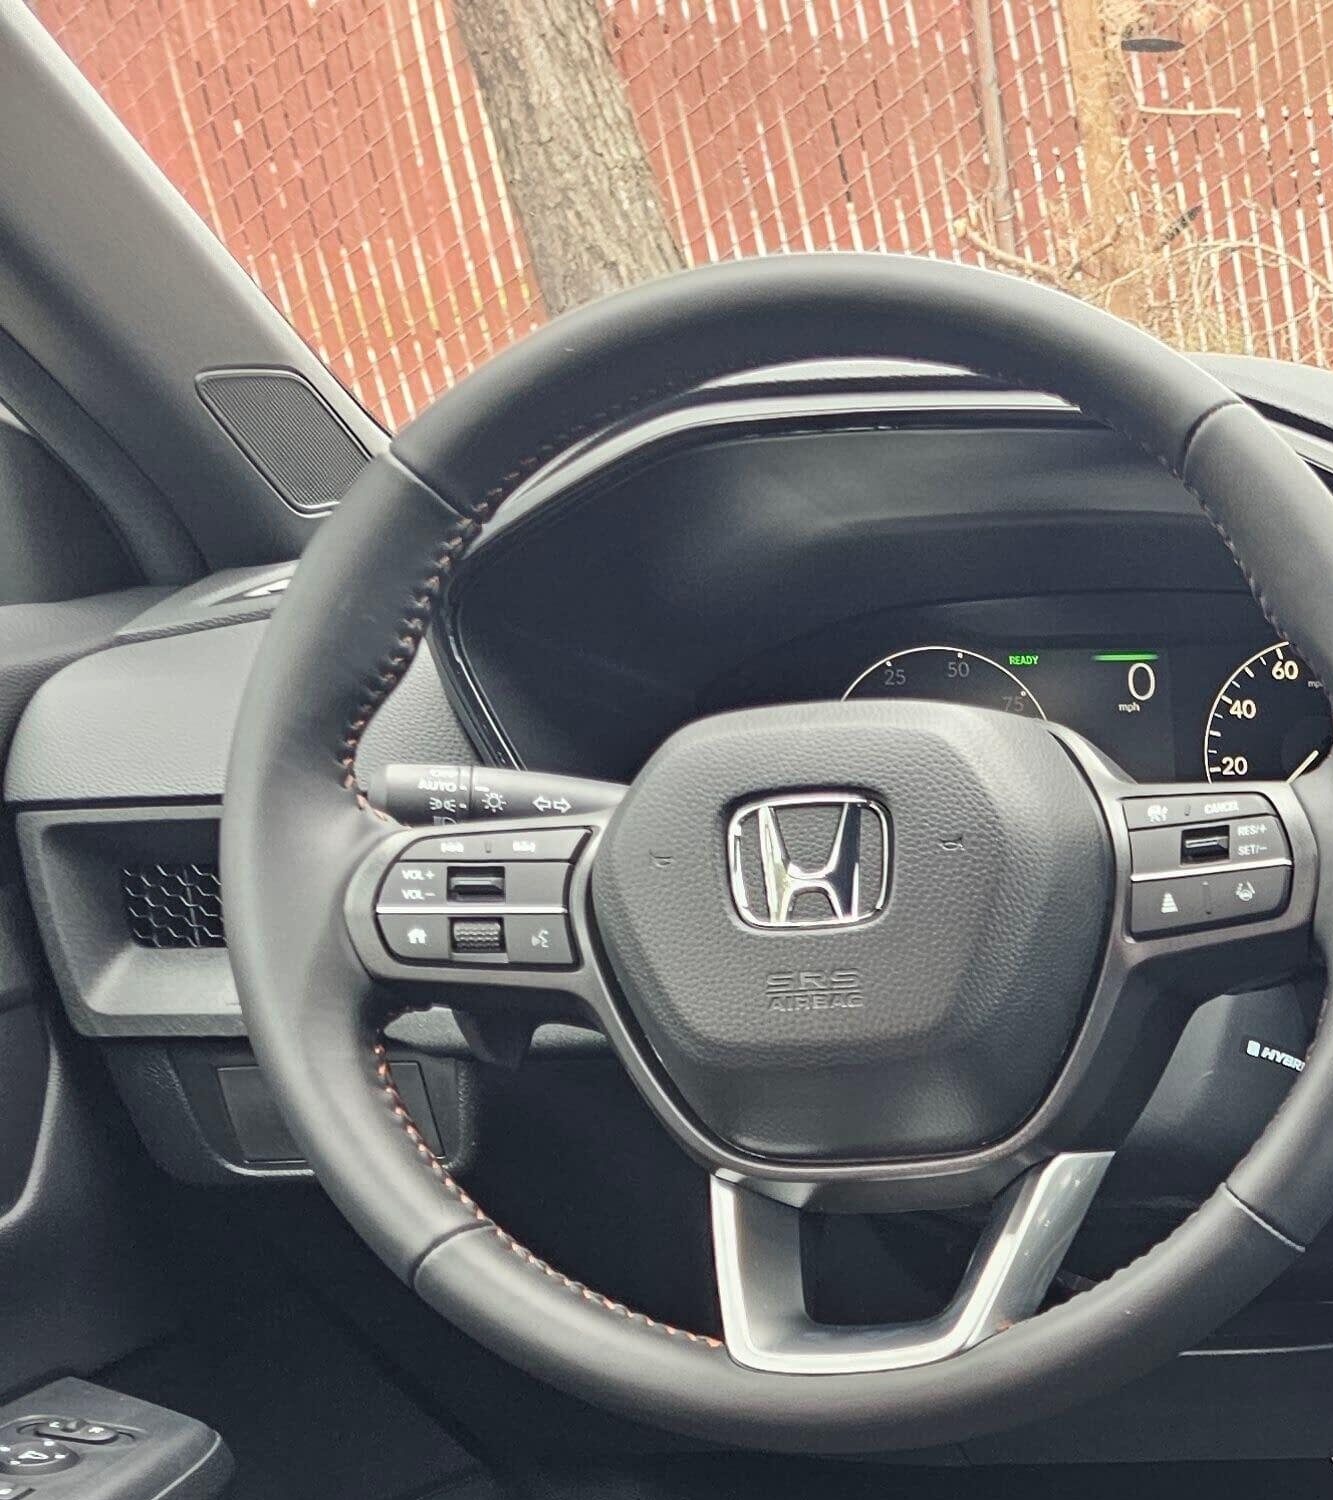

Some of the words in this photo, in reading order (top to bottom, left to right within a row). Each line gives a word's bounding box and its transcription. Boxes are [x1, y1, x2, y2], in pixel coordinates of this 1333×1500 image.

[947, 661, 970, 678] 50
[1008, 655, 1039, 666] READY
[884, 668, 906, 686] 25
[1271, 660, 1299, 680] 60
[1127, 662, 1156, 700] 0
[1307, 680, 1323, 689] mp
[1001, 695, 1025, 713] 75
[1118, 702, 1140, 714] mph
[1229, 699, 1257, 719] 40
[1221, 756, 1248, 776] 20
[418, 778, 457, 792] AUTO
[1204, 801, 1239, 814] CANCEL
[1261, 1046, 1305, 1072] HYBRI
